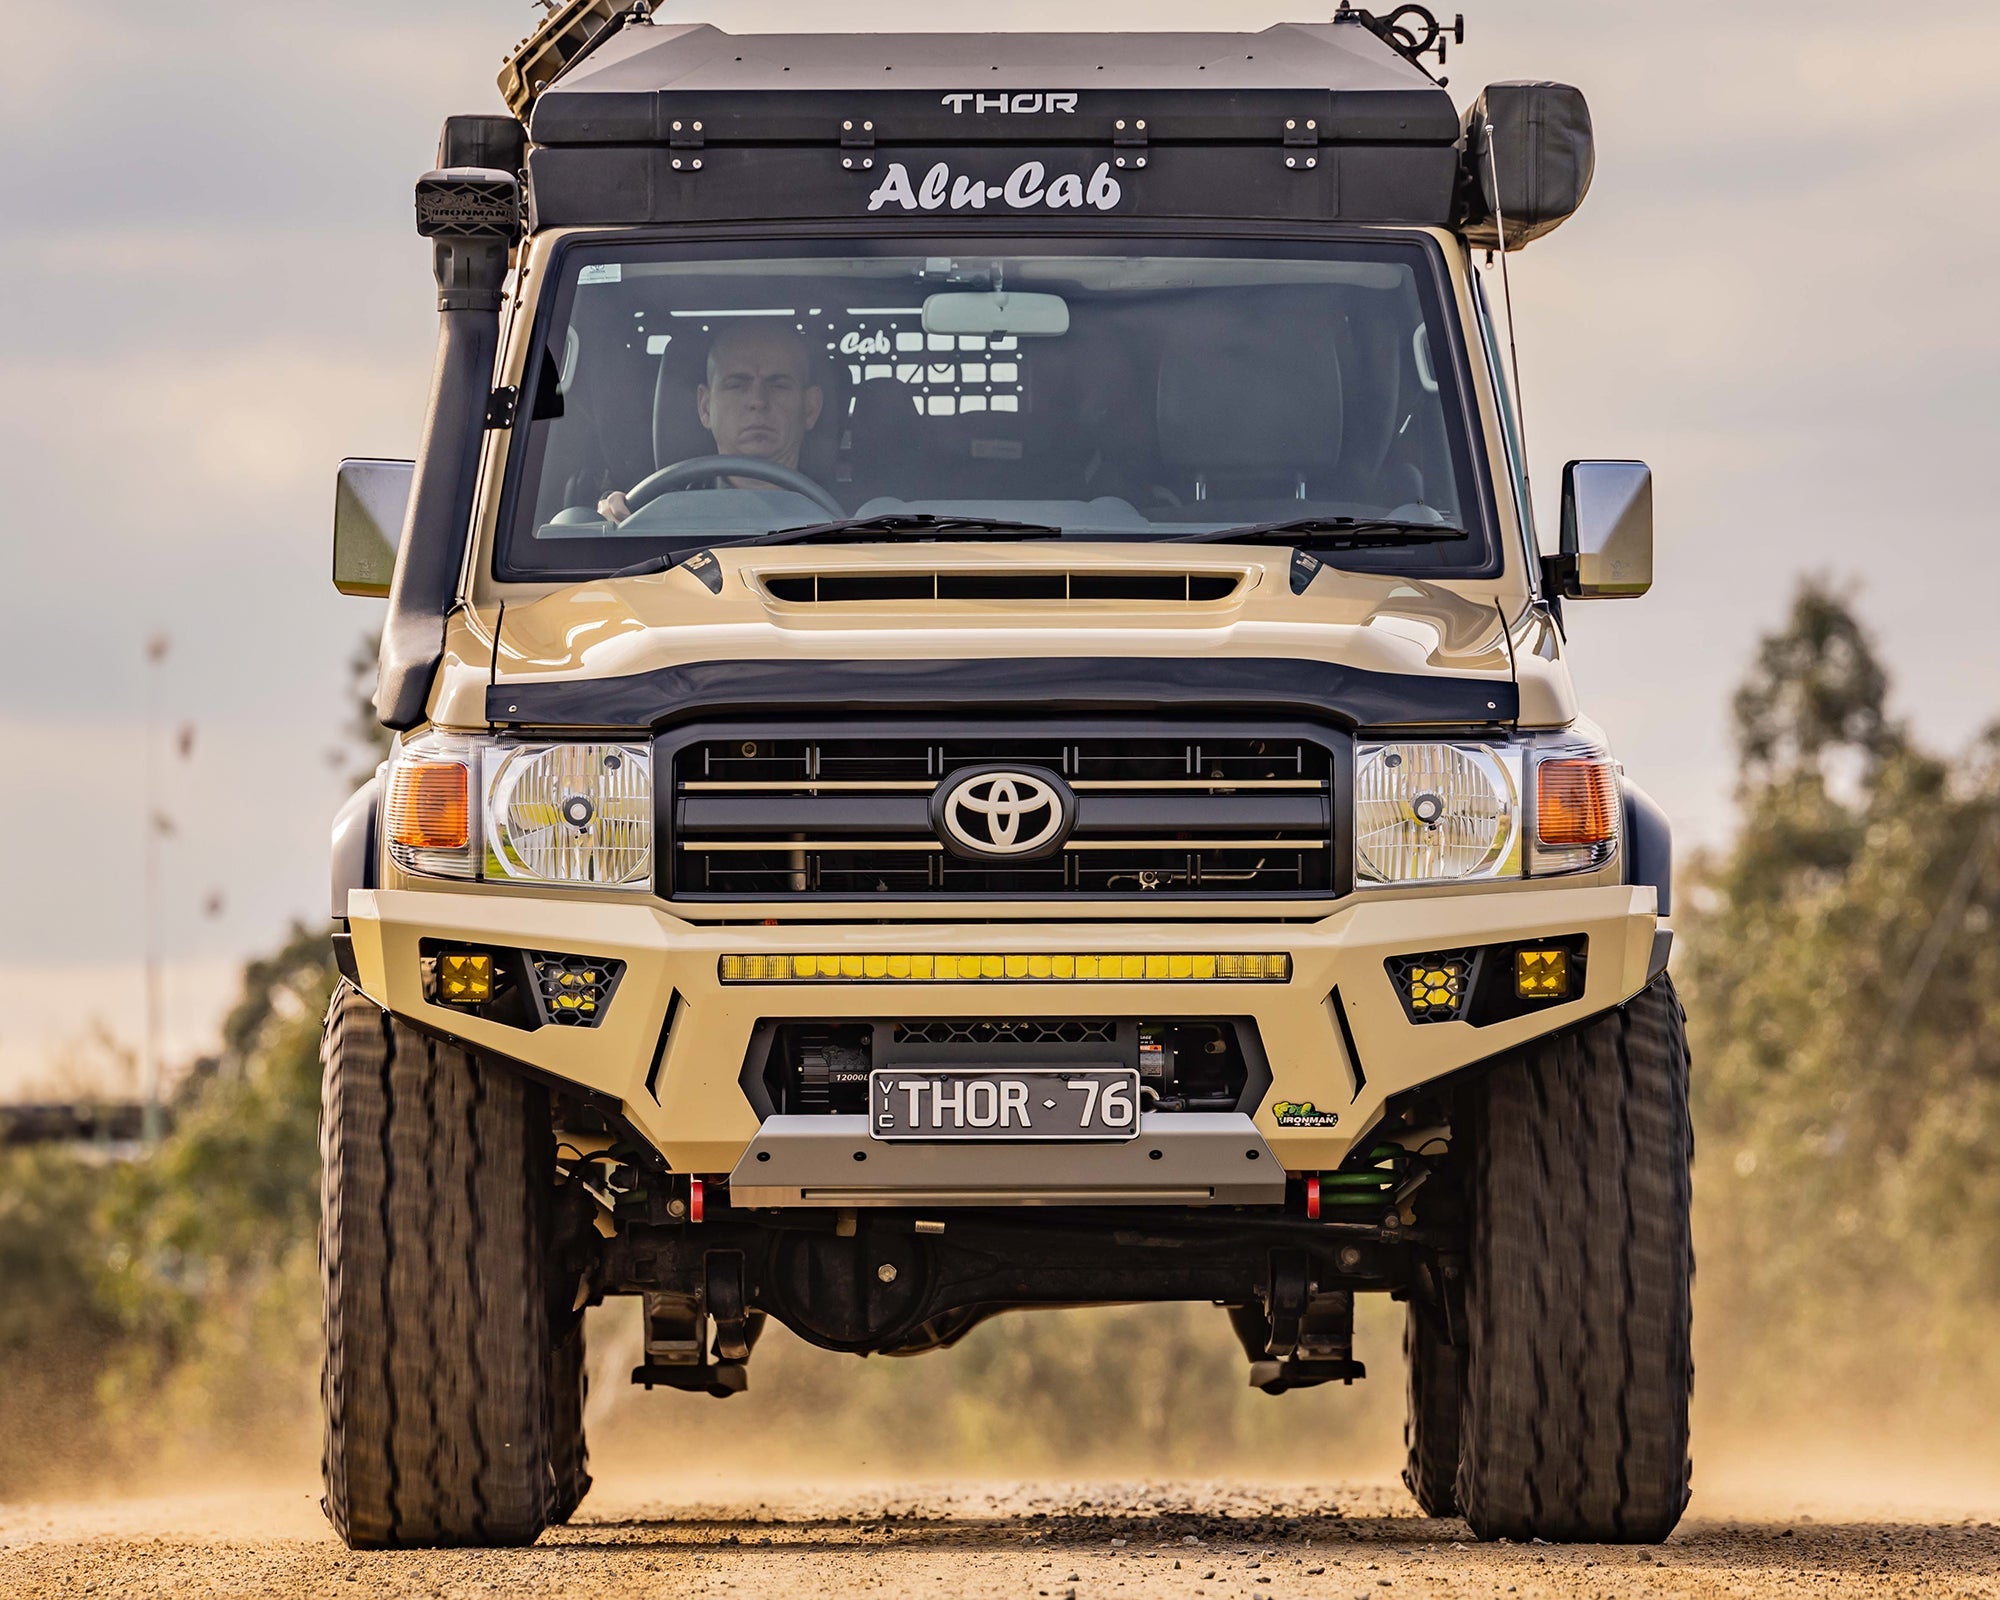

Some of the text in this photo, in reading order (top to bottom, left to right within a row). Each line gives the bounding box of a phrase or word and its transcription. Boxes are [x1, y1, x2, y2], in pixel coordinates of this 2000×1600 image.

[941, 93, 1078, 114] THOR
[867, 161, 1121, 211] Alu-Cab
[435, 209, 505, 217] IRONMAN
[839, 330, 891, 354] Cab
[898, 1081, 1133, 1128] THOR 76
